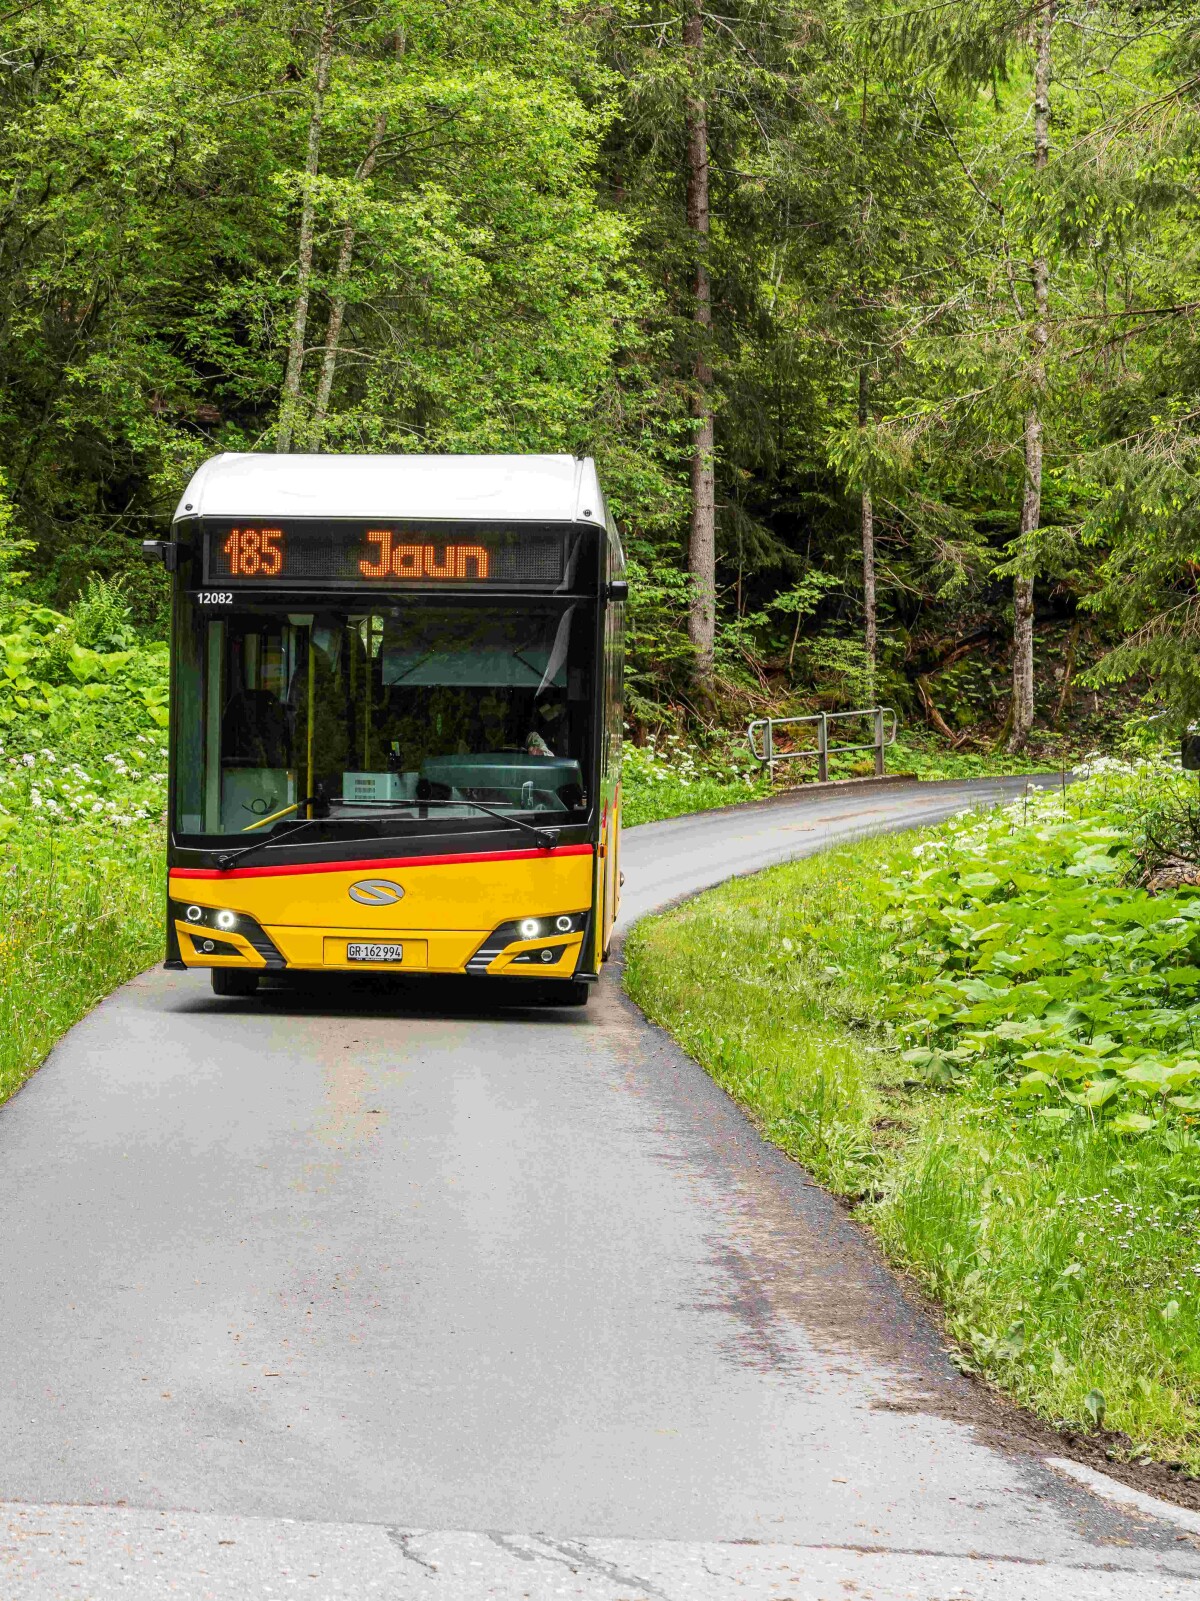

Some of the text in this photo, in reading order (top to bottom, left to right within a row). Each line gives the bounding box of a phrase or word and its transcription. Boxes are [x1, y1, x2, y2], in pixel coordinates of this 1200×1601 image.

[224, 529, 489, 579] 185 Jaun
[197, 592, 233, 605] 12082
